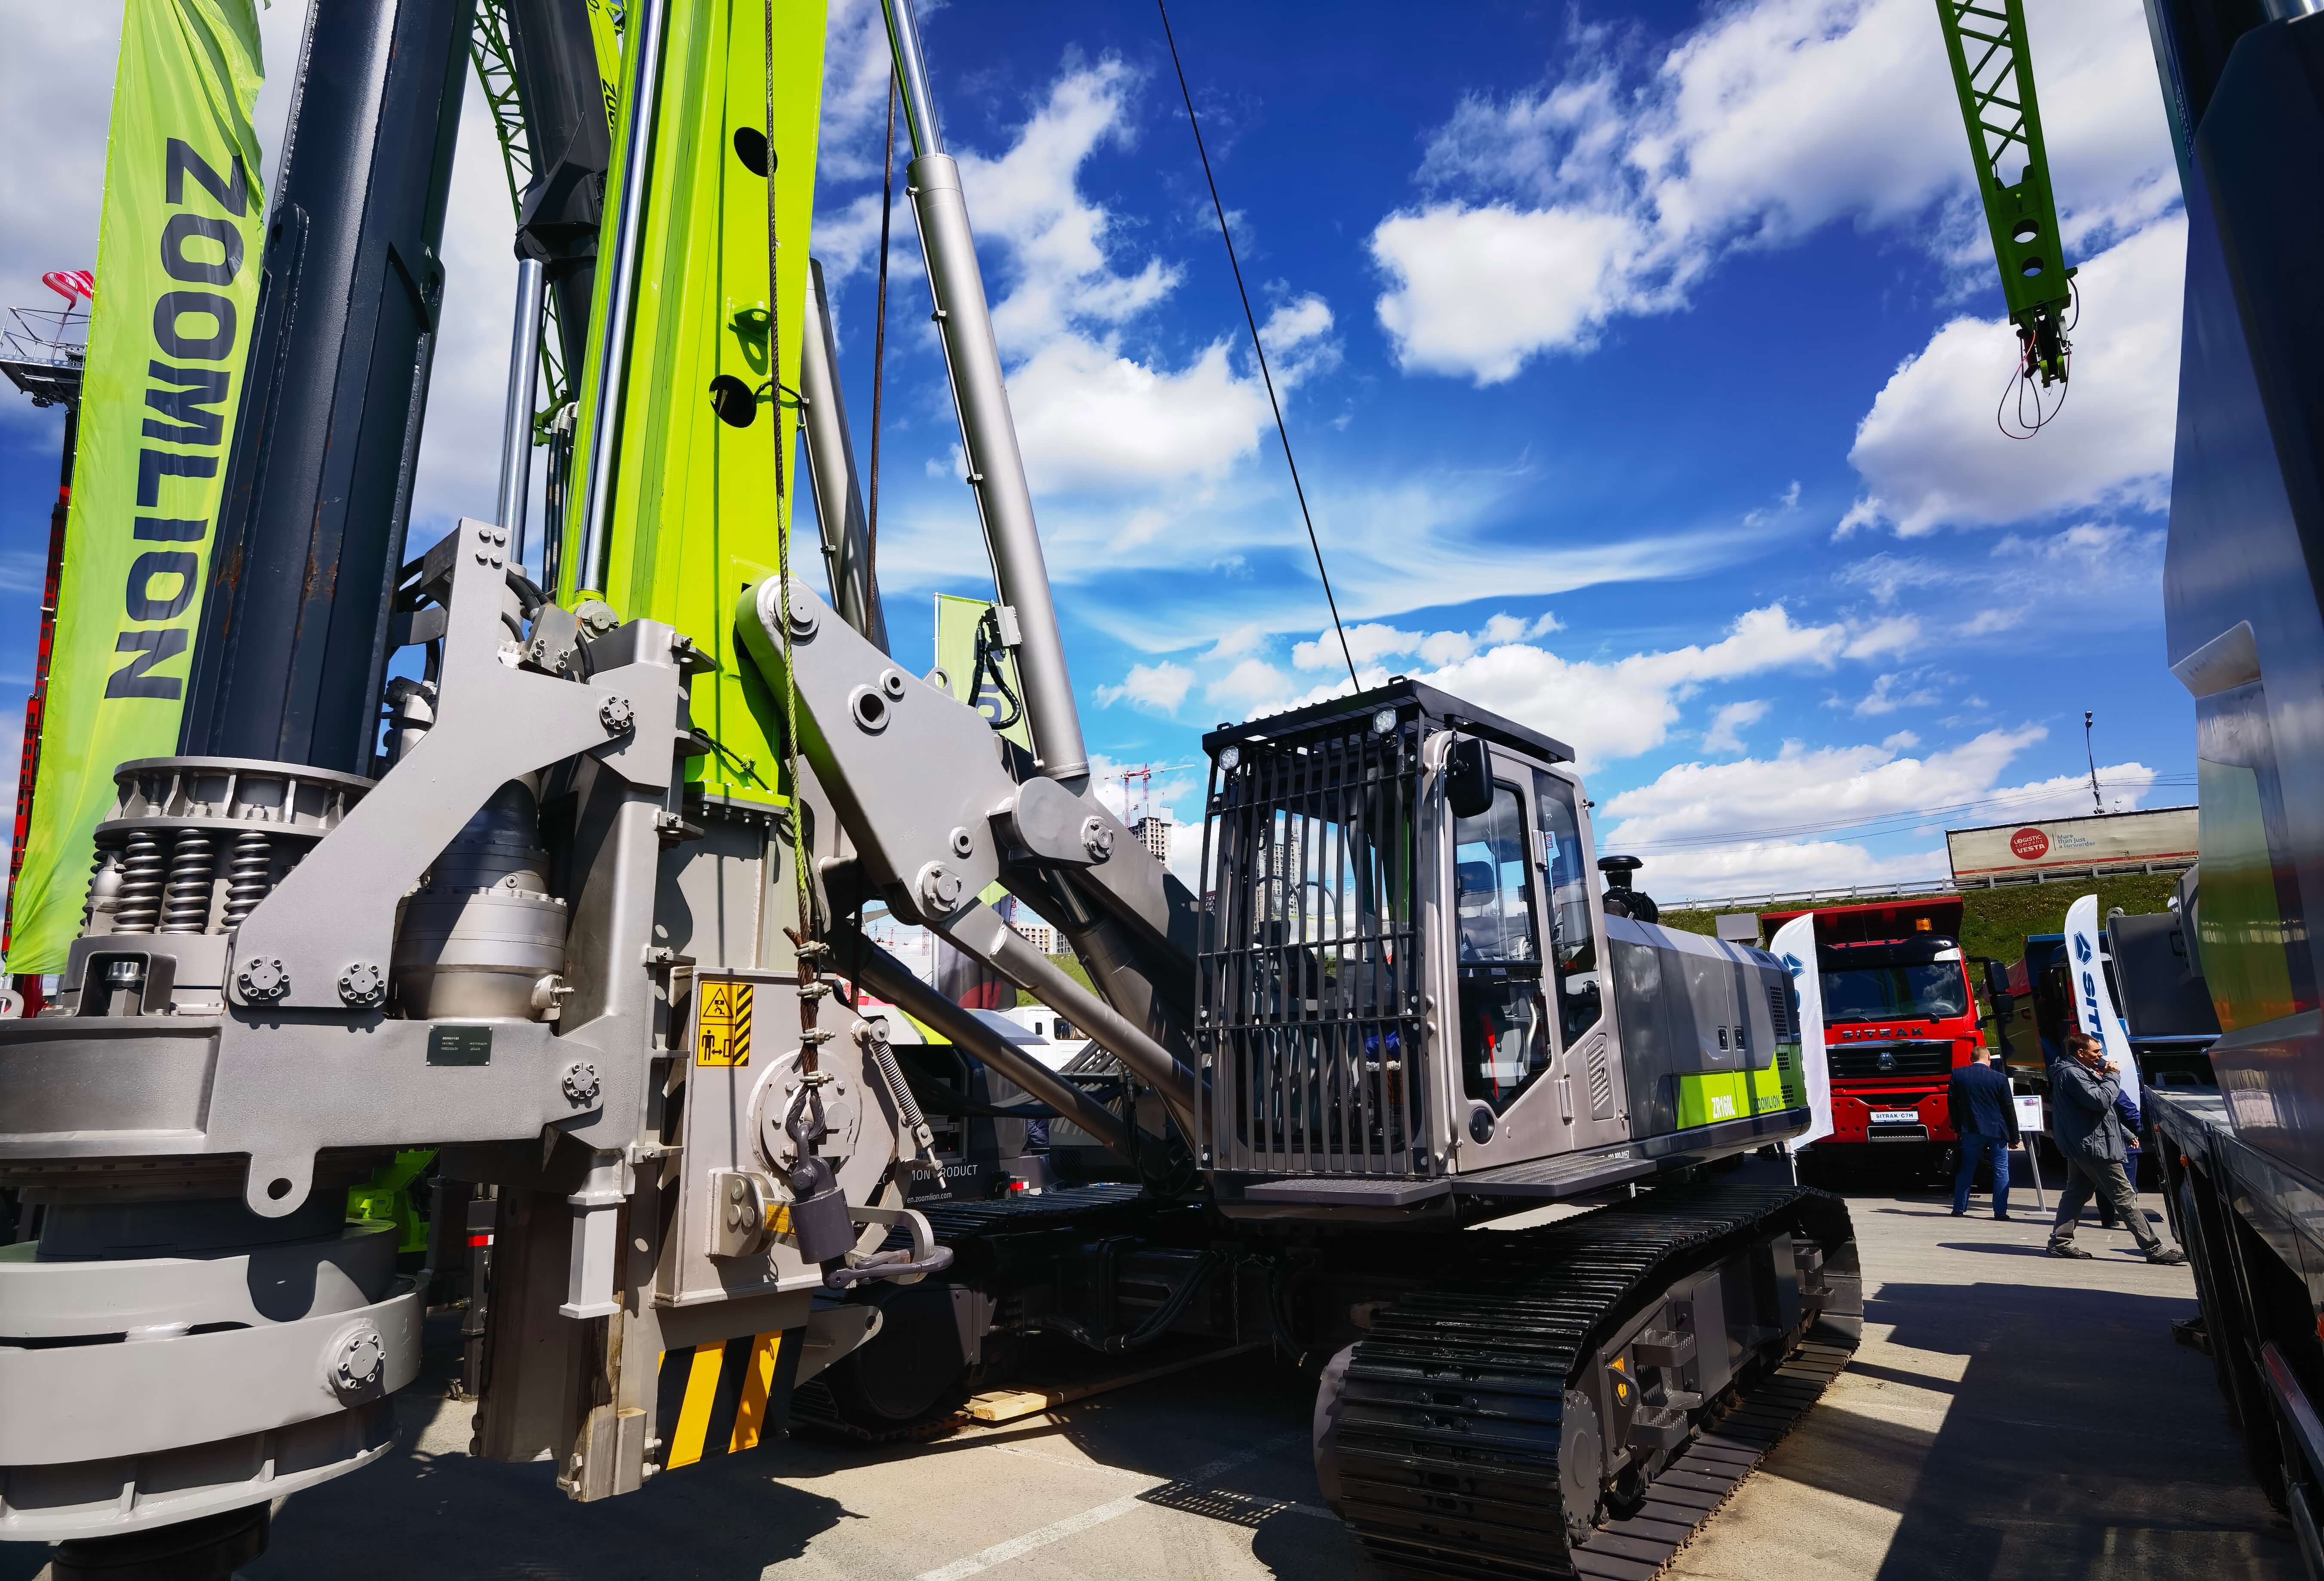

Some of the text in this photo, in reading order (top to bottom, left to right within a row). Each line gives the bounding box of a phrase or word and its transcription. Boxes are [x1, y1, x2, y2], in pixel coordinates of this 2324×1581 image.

[104, 137, 248, 701] ZOOMLION
[2014, 835, 2042, 845] LOGISTIC
[2015, 839, 2043, 848] company
[2017, 843, 2046, 853] VESTA
[1842, 1027, 1923, 1039] SITRAK
[1711, 1094, 1736, 1119] ZR160L
[1752, 1095, 1780, 1112] ZOOMLION
[941, 1165, 978, 1178] RODUCT
[907, 1192, 952, 1203] en.zoomlion.com
